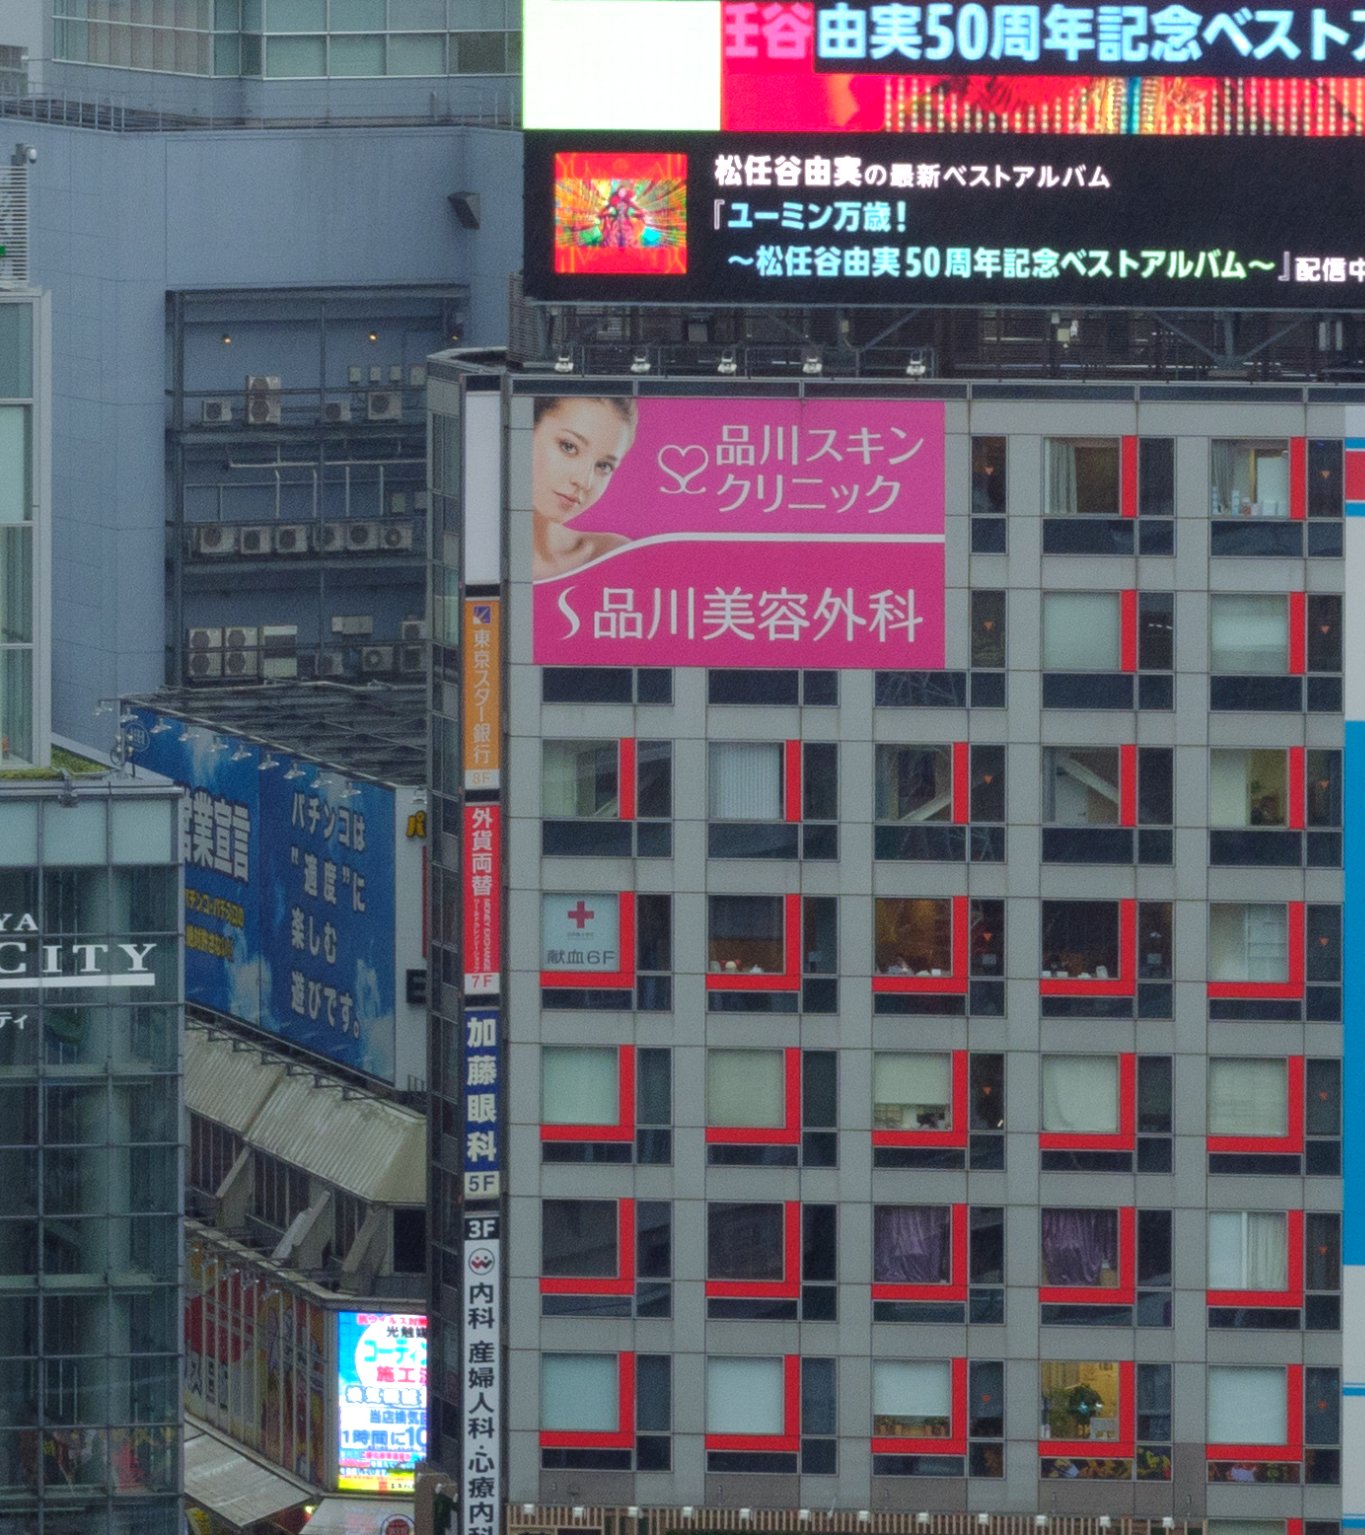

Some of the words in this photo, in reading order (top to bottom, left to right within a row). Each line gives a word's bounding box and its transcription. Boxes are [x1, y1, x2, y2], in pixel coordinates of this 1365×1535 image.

[714, 154, 1111, 189] 松任谷由実の最新ベストアルバム
[716, 425, 925, 466] 品川スキン
[716, 473, 901, 514] クリニック
[593, 586, 924, 643] 品川美容外科
[472, 627, 492, 765] 東京スター銀行
[472, 771, 491, 785] 8F
[291, 792, 366, 852] パチンコは
[471, 807, 493, 896] 外貨両替
[290, 906, 337, 964] 楽しむ
[0, 942, 158, 973] CITY
[546, 948, 616, 966] 献血6F
[472, 974, 494, 990] 7F
[290, 969, 361, 1039] 遊びです。
[467, 1017, 497, 1163] 加藤眼科
[468, 1175, 495, 1193] 5F
[468, 1220, 496, 1238] 3F
[468, 1282, 495, 1331] 内科
